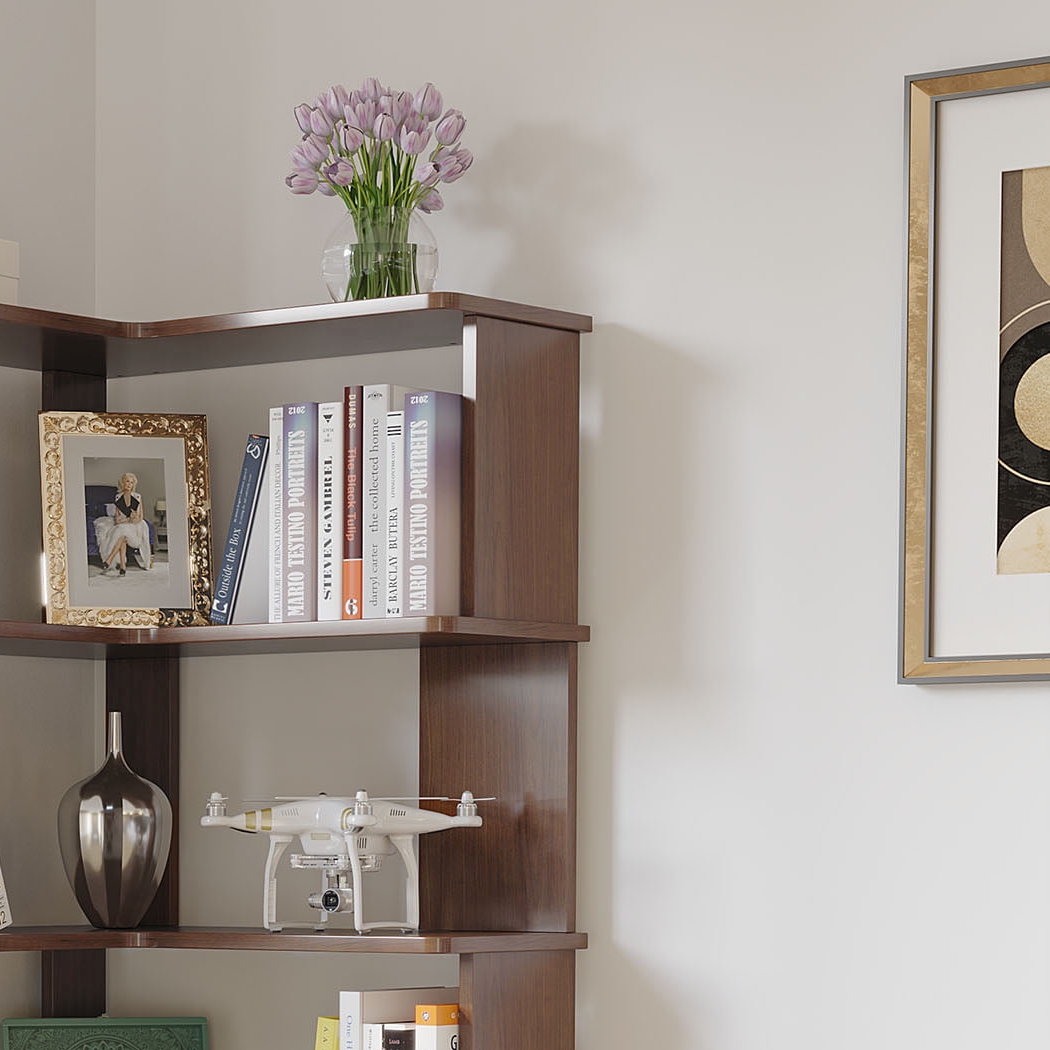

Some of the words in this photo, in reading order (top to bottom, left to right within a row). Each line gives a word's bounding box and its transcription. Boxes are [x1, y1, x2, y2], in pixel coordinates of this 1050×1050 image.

[288, 406, 306, 415] 2012
[348, 394, 356, 429] DUMAS
[411, 395, 428, 405] 2012
[369, 418, 379, 453] home
[347, 447, 357, 470] The
[323, 455, 333, 533] GAMBREL
[347, 474, 357, 509] Black
[369, 456, 379, 509] collected
[274, 489, 282, 518] ITALIAN
[229, 527, 242, 546] Box
[274, 519, 282, 535] AND
[287, 511, 305, 568] TESTINO
[345, 511, 357, 542] Tulip
[369, 513, 378, 533] the
[388, 507, 398, 549] BUTERA
[409, 503, 428, 561] TESTINO
[225, 546, 237, 563] the
[274, 537, 282, 565] FRENCH
[217, 563, 233, 599] Outside
[323, 539, 333, 600] STEVEN
[388, 556, 398, 602] BARCLAY
[287, 571, 305, 617] MARIO
[369, 576, 380, 606] darryl
[409, 564, 428, 611] MARIO
